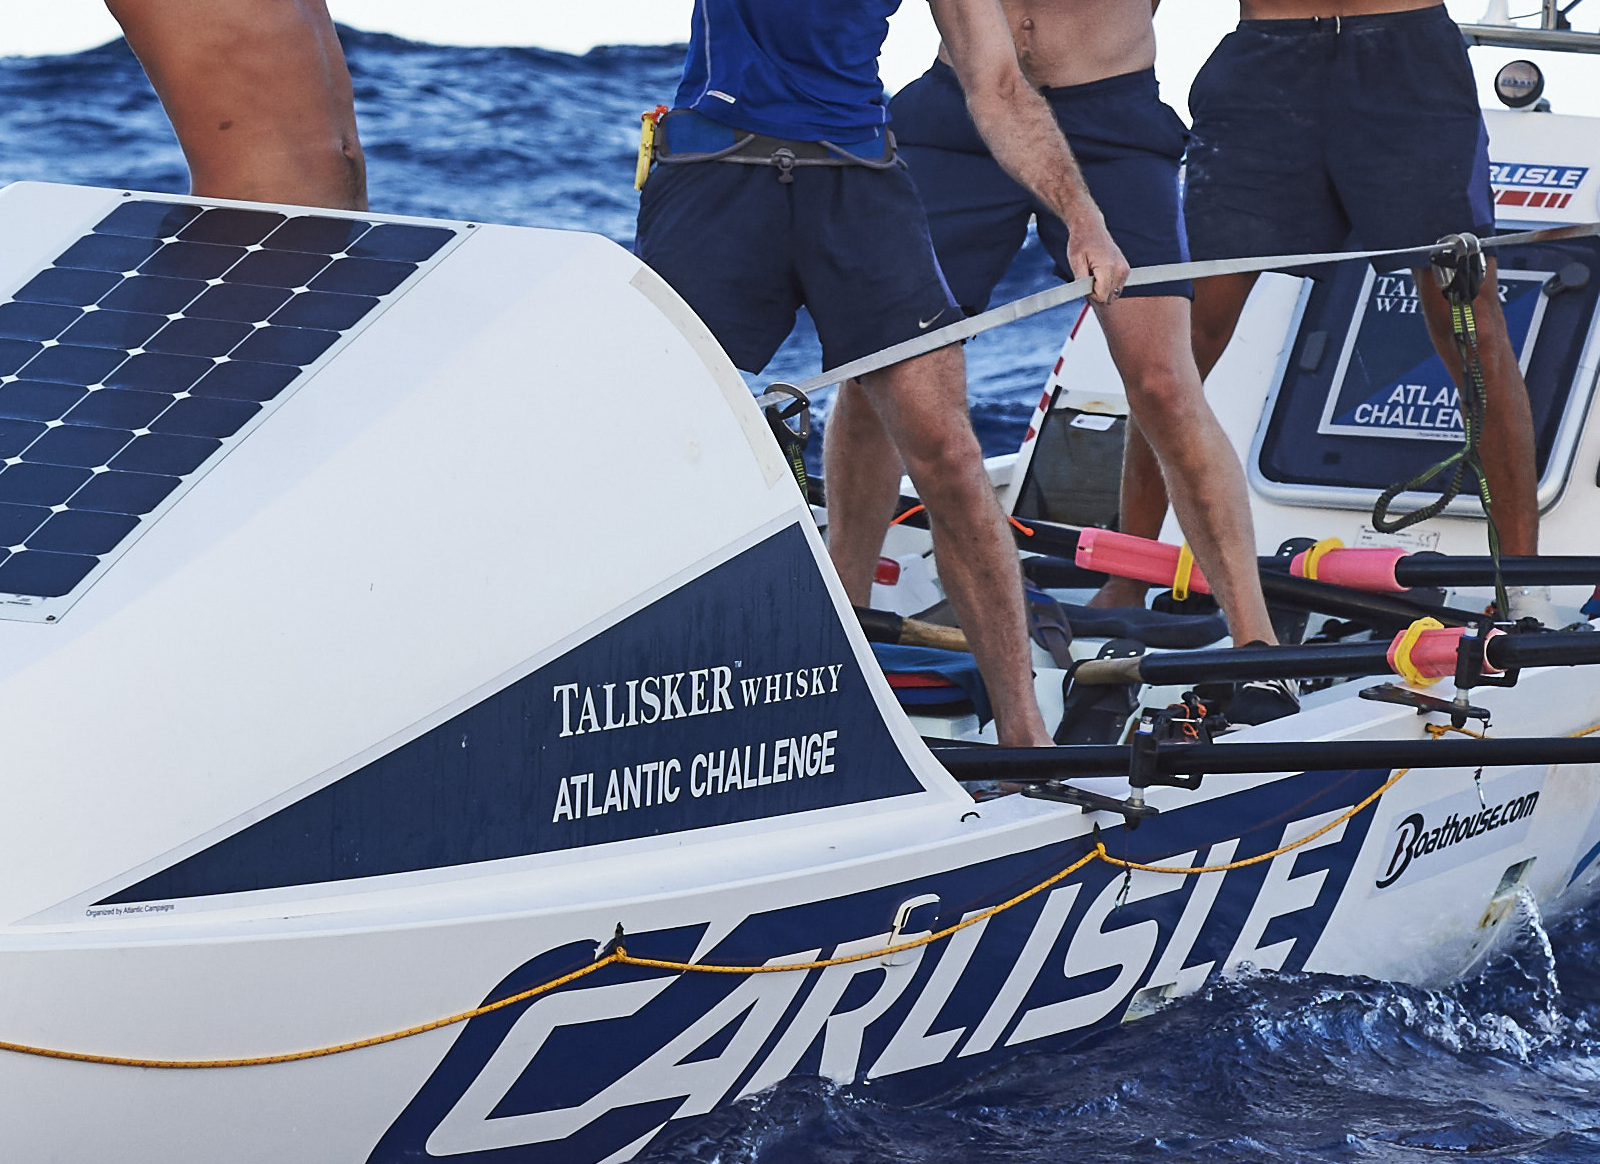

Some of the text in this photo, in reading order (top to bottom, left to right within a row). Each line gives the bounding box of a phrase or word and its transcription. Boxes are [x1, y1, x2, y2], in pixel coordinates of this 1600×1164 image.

[1489, 164, 1583, 186] RLISLE
[1354, 403, 1465, 429] CHALLEN
[553, 663, 844, 738] TALISKER WHISKY
[552, 729, 839, 823] ATLANTIC CHALLENGE
[1375, 790, 1540, 889] Boathouse.com
[86, 908, 115, 918] Organized
[123, 906, 144, 914] Atlantic
[144, 904, 175, 913] Campaigns
[425, 808, 1353, 1158] CARLISLE
